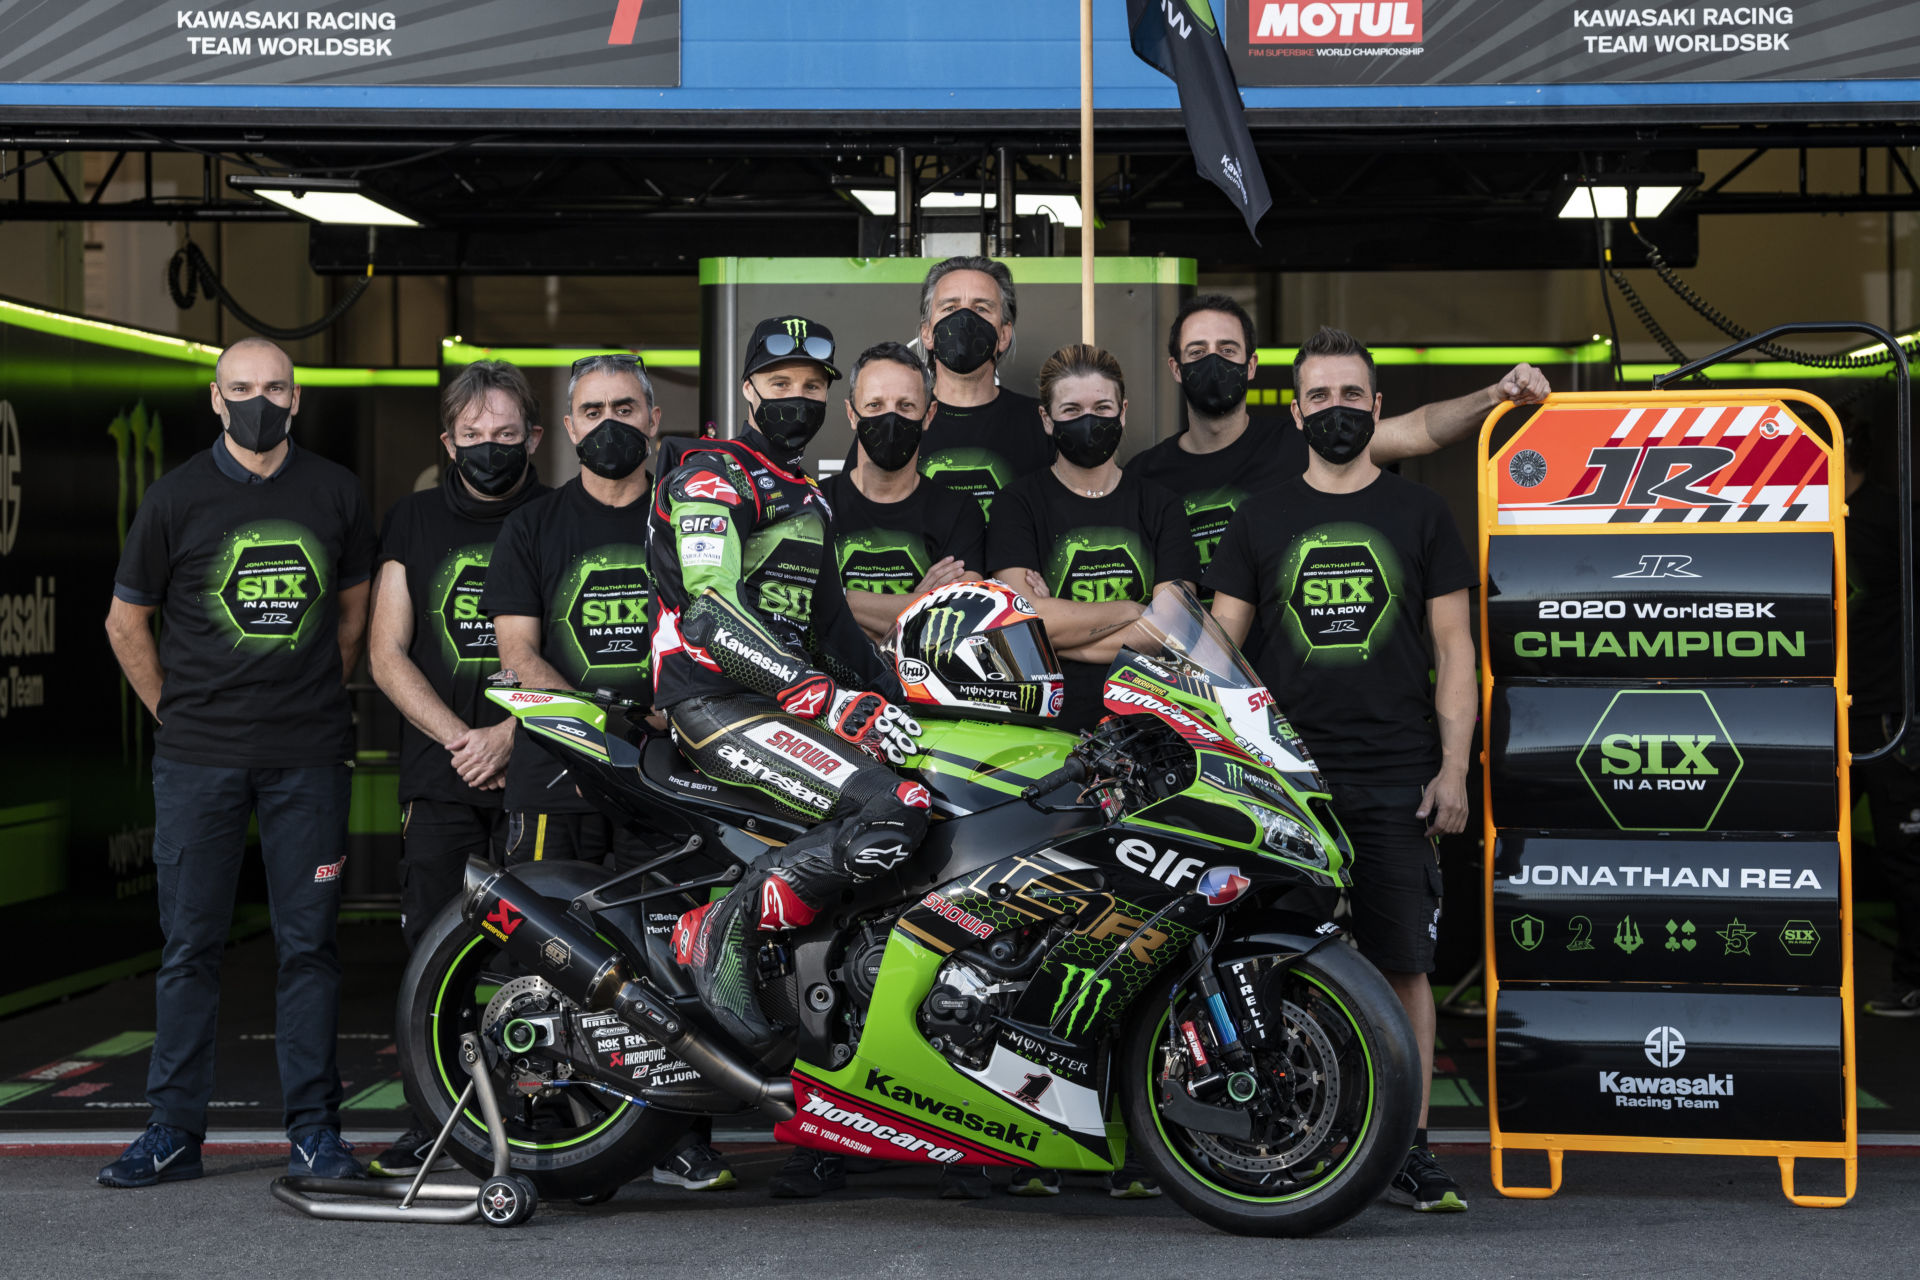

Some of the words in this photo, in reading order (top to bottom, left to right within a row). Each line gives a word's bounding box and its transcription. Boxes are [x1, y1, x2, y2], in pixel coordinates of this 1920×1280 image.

[177, 10, 299, 29] KAWASAKI
[306, 12, 396, 31] RACING
[1256, 2, 1415, 37] MOTUL
[1573, 9, 1695, 27] KAWASAKI
[1703, 7, 1793, 26] RACING
[187, 37, 250, 55] TEAM
[257, 38, 392, 56] WORLDSBK
[1249, 49, 1264, 57] FIM
[1266, 48, 1315, 57] SUPERBIKE
[1316, 48, 1352, 57] WORLD
[1353, 47, 1425, 57] CHAMPIONSHIP
[1584, 35, 1647, 53] TEAM
[1654, 33, 1790, 52] WORLDSBK
[681, 517, 710, 532] elf
[245, 560, 284, 568] JONATHAN
[1611, 554, 1703, 579] JR
[237, 573, 307, 601] SIX
[847, 579, 914, 595] SIX
[1071, 577, 1133, 603] SIX
[1303, 577, 1374, 606] SIX
[243, 601, 257, 609] IN
[582, 598, 649, 627] SIX
[1311, 608, 1324, 616] IN
[1326, 607, 1335, 615] A
[1337, 605, 1366, 614] ROW
[1538, 600, 1626, 619] 2020
[1634, 602, 1776, 619] WorldSBK
[0, 576, 55, 656] asaki
[460, 622, 472, 630] IN
[589, 628, 602, 636] IN
[603, 627, 613, 635] A
[615, 626, 644, 635] ROW
[713, 627, 799, 683] Kawasaki
[1513, 630, 1806, 659] CHAMPION
[900, 661, 924, 677] Arai
[1133, 655, 1170, 678] Puig
[1191, 670, 1210, 683] CMS
[509, 693, 553, 703] SHOWA
[960, 685, 1017, 700] MONSTER
[556, 723, 587, 738] 1000
[765, 730, 842, 776] SHOWA
[1234, 736, 1263, 756] elf
[1600, 733, 1719, 775] SIX
[668, 775, 689, 788] RACE
[690, 781, 718, 791] SEATS
[717, 744, 832, 811] alpinestars
[1613, 779, 1634, 791] IN
[1638, 779, 1654, 791] A
[1656, 779, 1706, 791] ROW
[1115, 838, 1206, 888] elf
[1509, 864, 1730, 889] JONATHAN
[1740, 868, 1822, 890] REA
[921, 891, 994, 940] SHOWA
[1522, 920, 1535, 945] 1
[1726, 923, 1749, 953] 5
[1785, 930, 1814, 940] SIX
[1232, 962, 1266, 1039] PIRELLI
[582, 1013, 618, 1028] PIRELL
[597, 1038, 620, 1049] NGK
[1009, 1031, 1088, 1075] MONSTER
[1016, 1072, 1053, 1101] 1
[1600, 1071, 1734, 1096] Kawasaki
[864, 1069, 1042, 1153] Kawasaki
[1615, 1095, 1671, 1110] Racing
[1675, 1096, 1719, 1109] Team
[799, 1121, 818, 1135] FUEL
[820, 1128, 838, 1142] YOUR
[839, 1135, 872, 1154] PASSION
